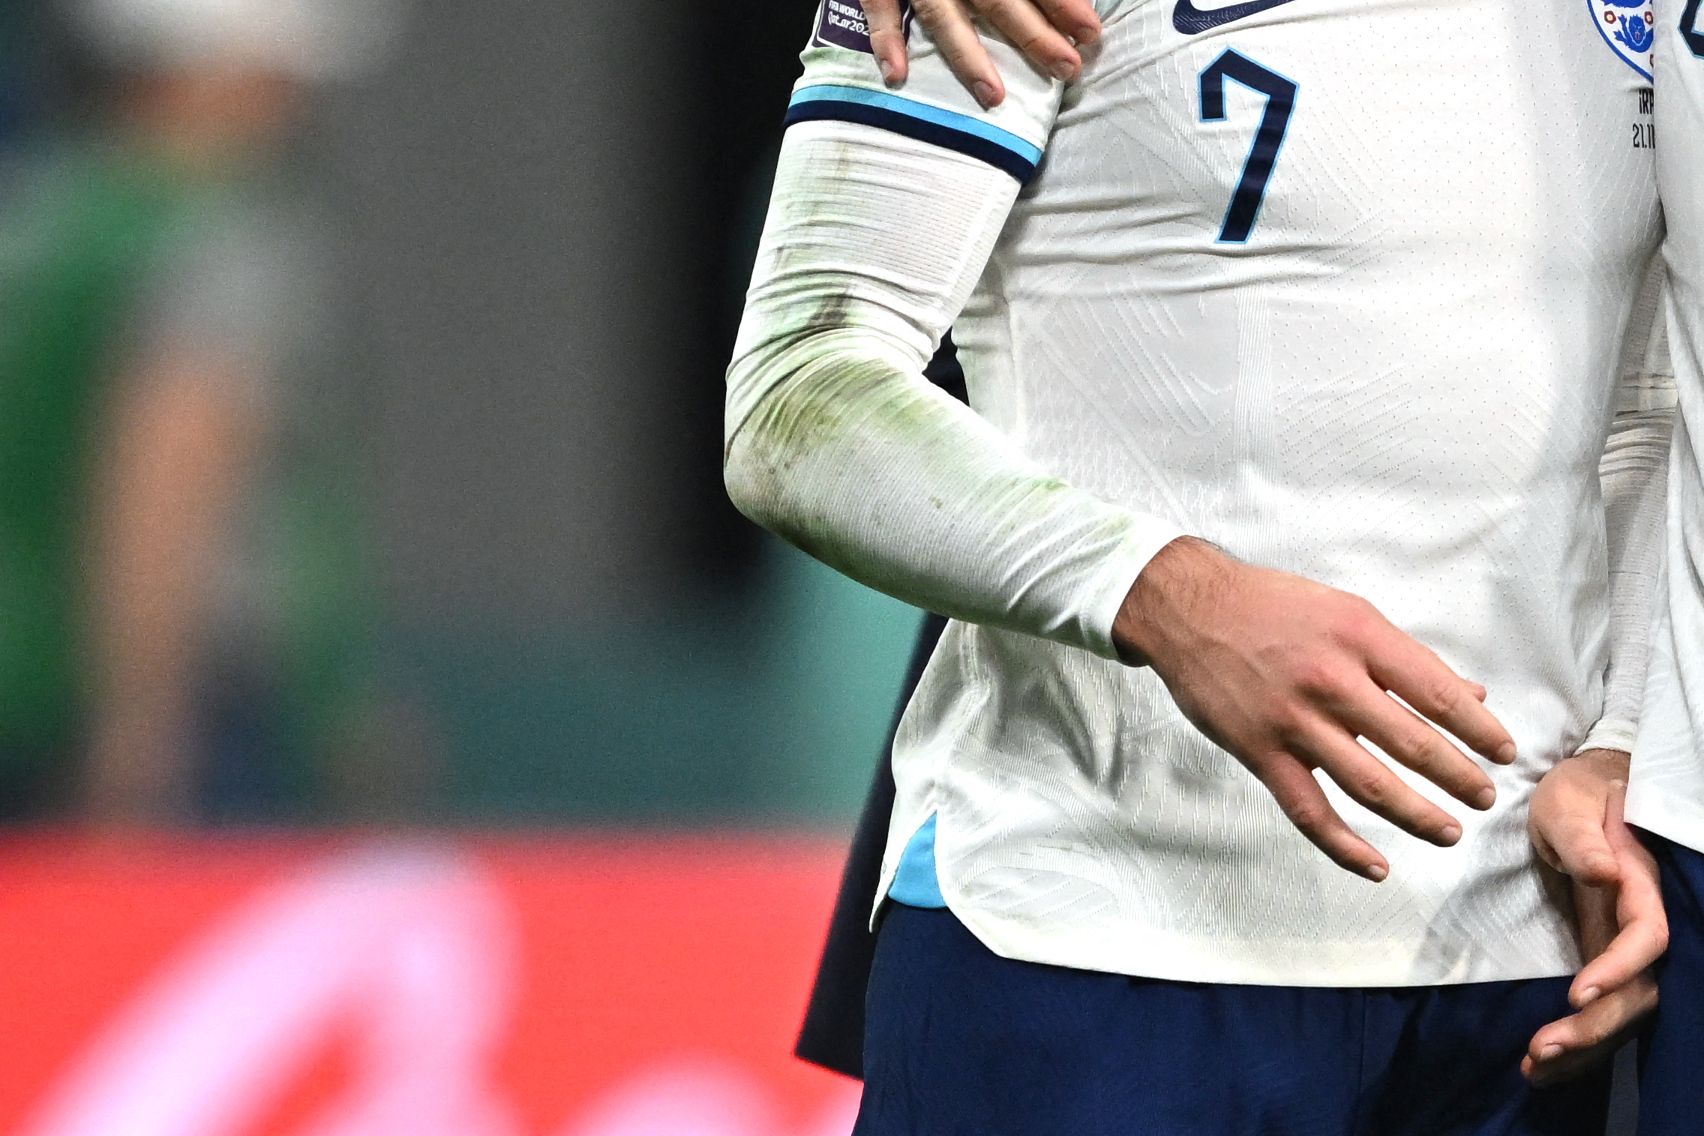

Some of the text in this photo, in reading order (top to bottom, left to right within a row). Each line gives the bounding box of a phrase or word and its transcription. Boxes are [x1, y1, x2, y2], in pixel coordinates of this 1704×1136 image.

[828, 10, 870, 36] Qatar202
[1199, 45, 1300, 244] 7
[1632, 123, 1655, 149] 21.11
